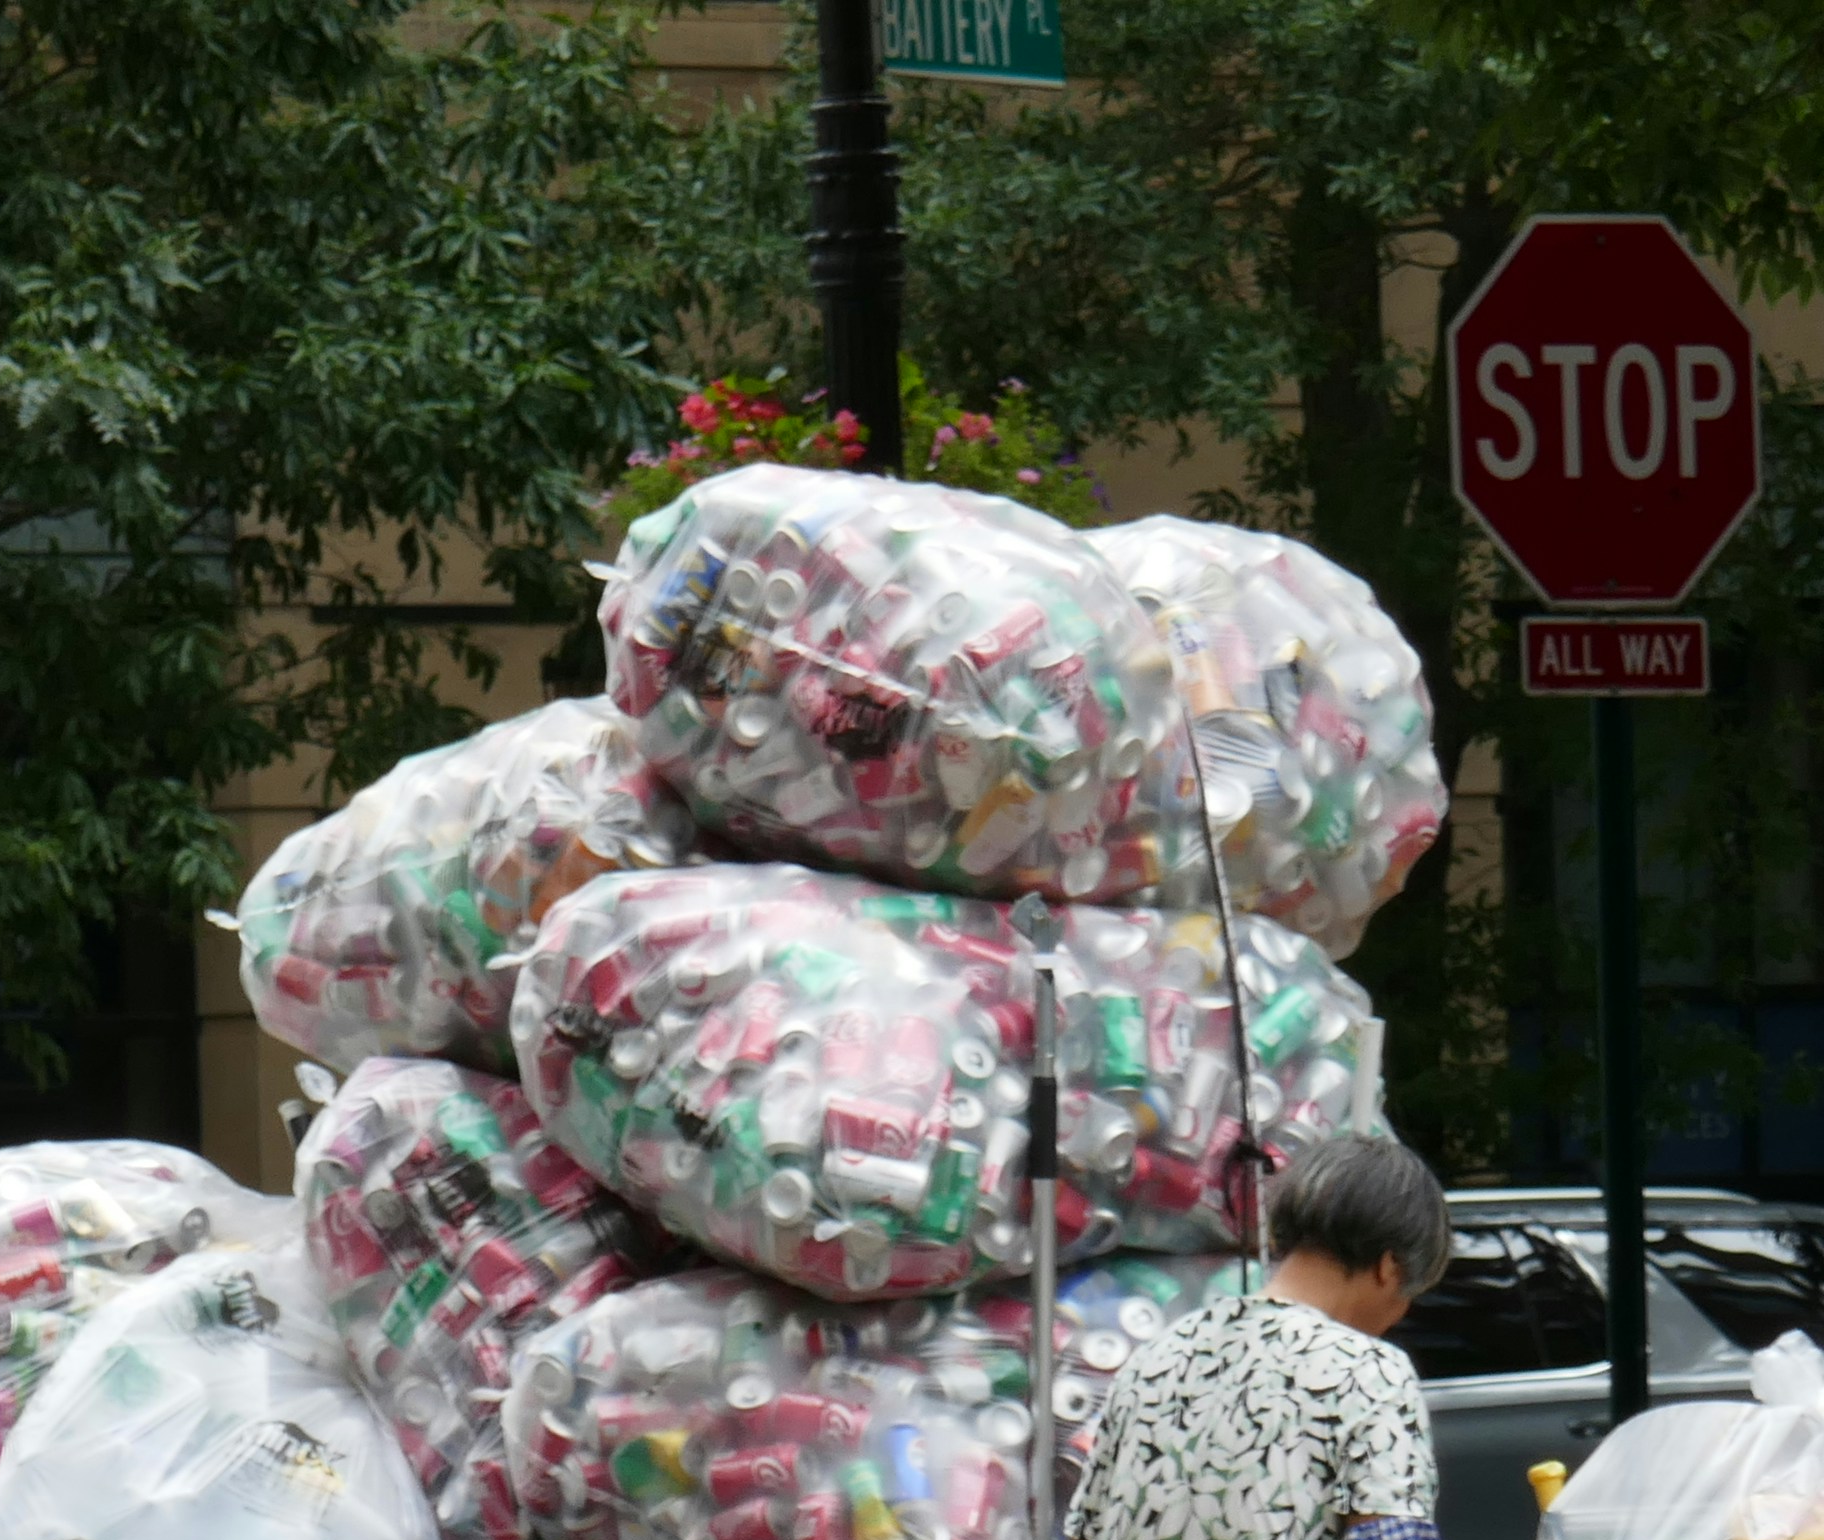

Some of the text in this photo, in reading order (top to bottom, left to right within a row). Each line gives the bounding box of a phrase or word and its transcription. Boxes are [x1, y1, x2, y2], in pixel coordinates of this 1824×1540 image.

[1477, 343, 1736, 479] STOP
[1539, 634, 1692, 676] ALL WAY
